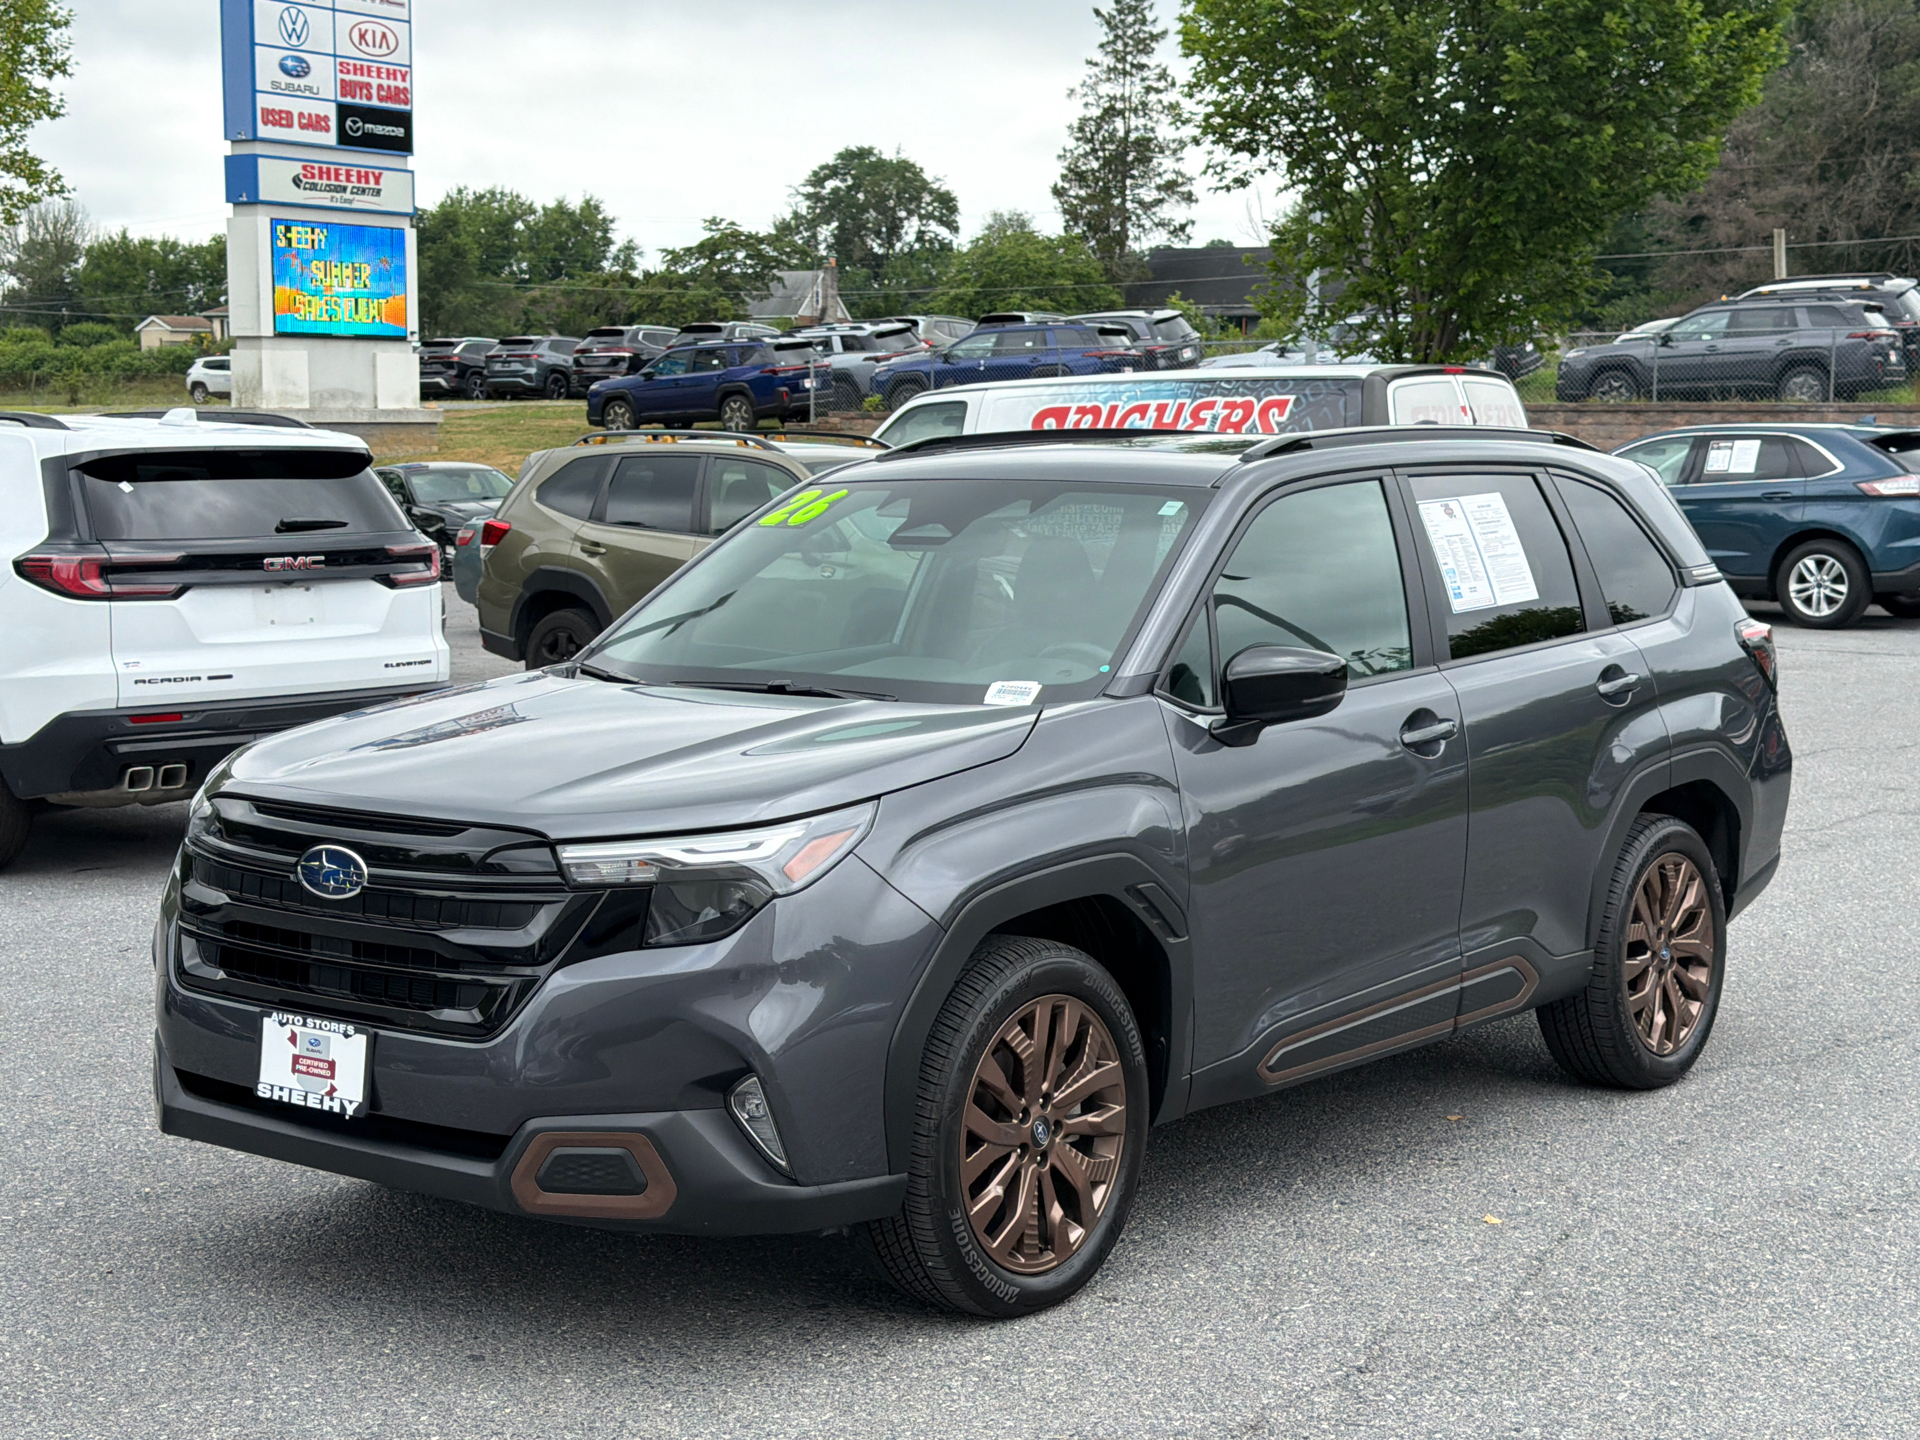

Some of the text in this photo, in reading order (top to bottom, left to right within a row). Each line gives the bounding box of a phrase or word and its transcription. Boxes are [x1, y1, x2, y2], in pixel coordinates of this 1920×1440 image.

[358, 27, 391, 51] KIA
[338, 61, 409, 83] SHEEHY
[270, 80, 320, 95] SUBARU
[340, 79, 410, 106] BUYS CARS
[260, 106, 331, 133] USED CARS
[364, 123, 405, 137] mazda
[301, 164, 384, 186] SHEEHY
[302, 181, 382, 197] COLLISION CENTER
[263, 555, 325, 571] GMC
[384, 659, 432, 668] ELEVATION
[134, 676, 202, 685] ACADIA
[271, 1012, 355, 1035] AUTO STORES
[1083, 972, 1145, 1066] BRIDGESTONE
[295, 1065, 331, 1077] PRE-OWNED
[299, 1058, 329, 1069] CERTIFIED
[257, 1082, 360, 1116] SHEEHY
[948, 1207, 1021, 1304] BRIDGESTONE
